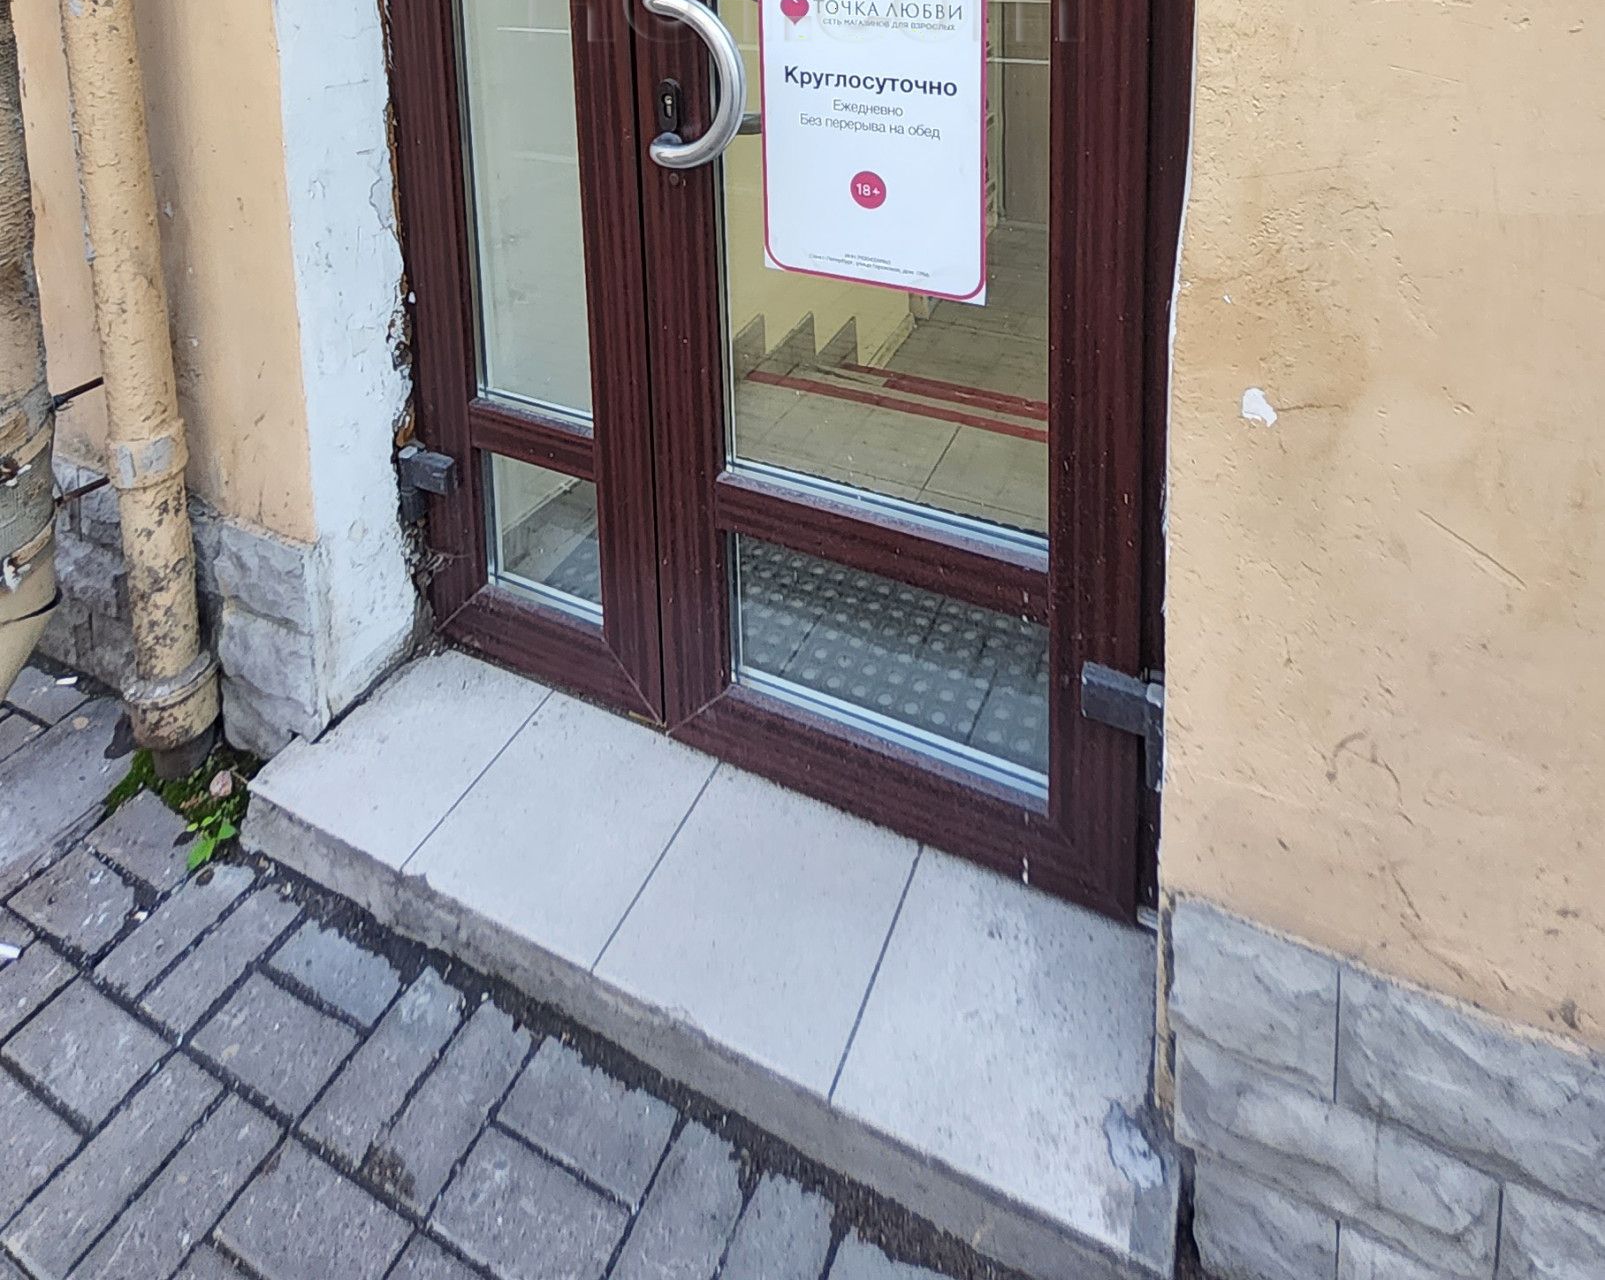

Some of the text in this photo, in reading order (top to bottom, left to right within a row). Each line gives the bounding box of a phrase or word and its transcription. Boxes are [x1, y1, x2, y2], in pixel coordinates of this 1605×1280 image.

[813, 0, 962, 20] ТОЧКА ЛЮБВИ
[844, 19, 890, 28] МАГАЗИНОВ
[891, 21, 910, 30] ДЛЯ
[911, 22, 956, 31] ВЗРОСЛЫХ
[784, 65, 957, 96] Круглосуточно
[833, 99, 903, 117] Ежедневно
[800, 113, 940, 140] Без перерыва на обед
[856, 183, 880, 197] 18+
